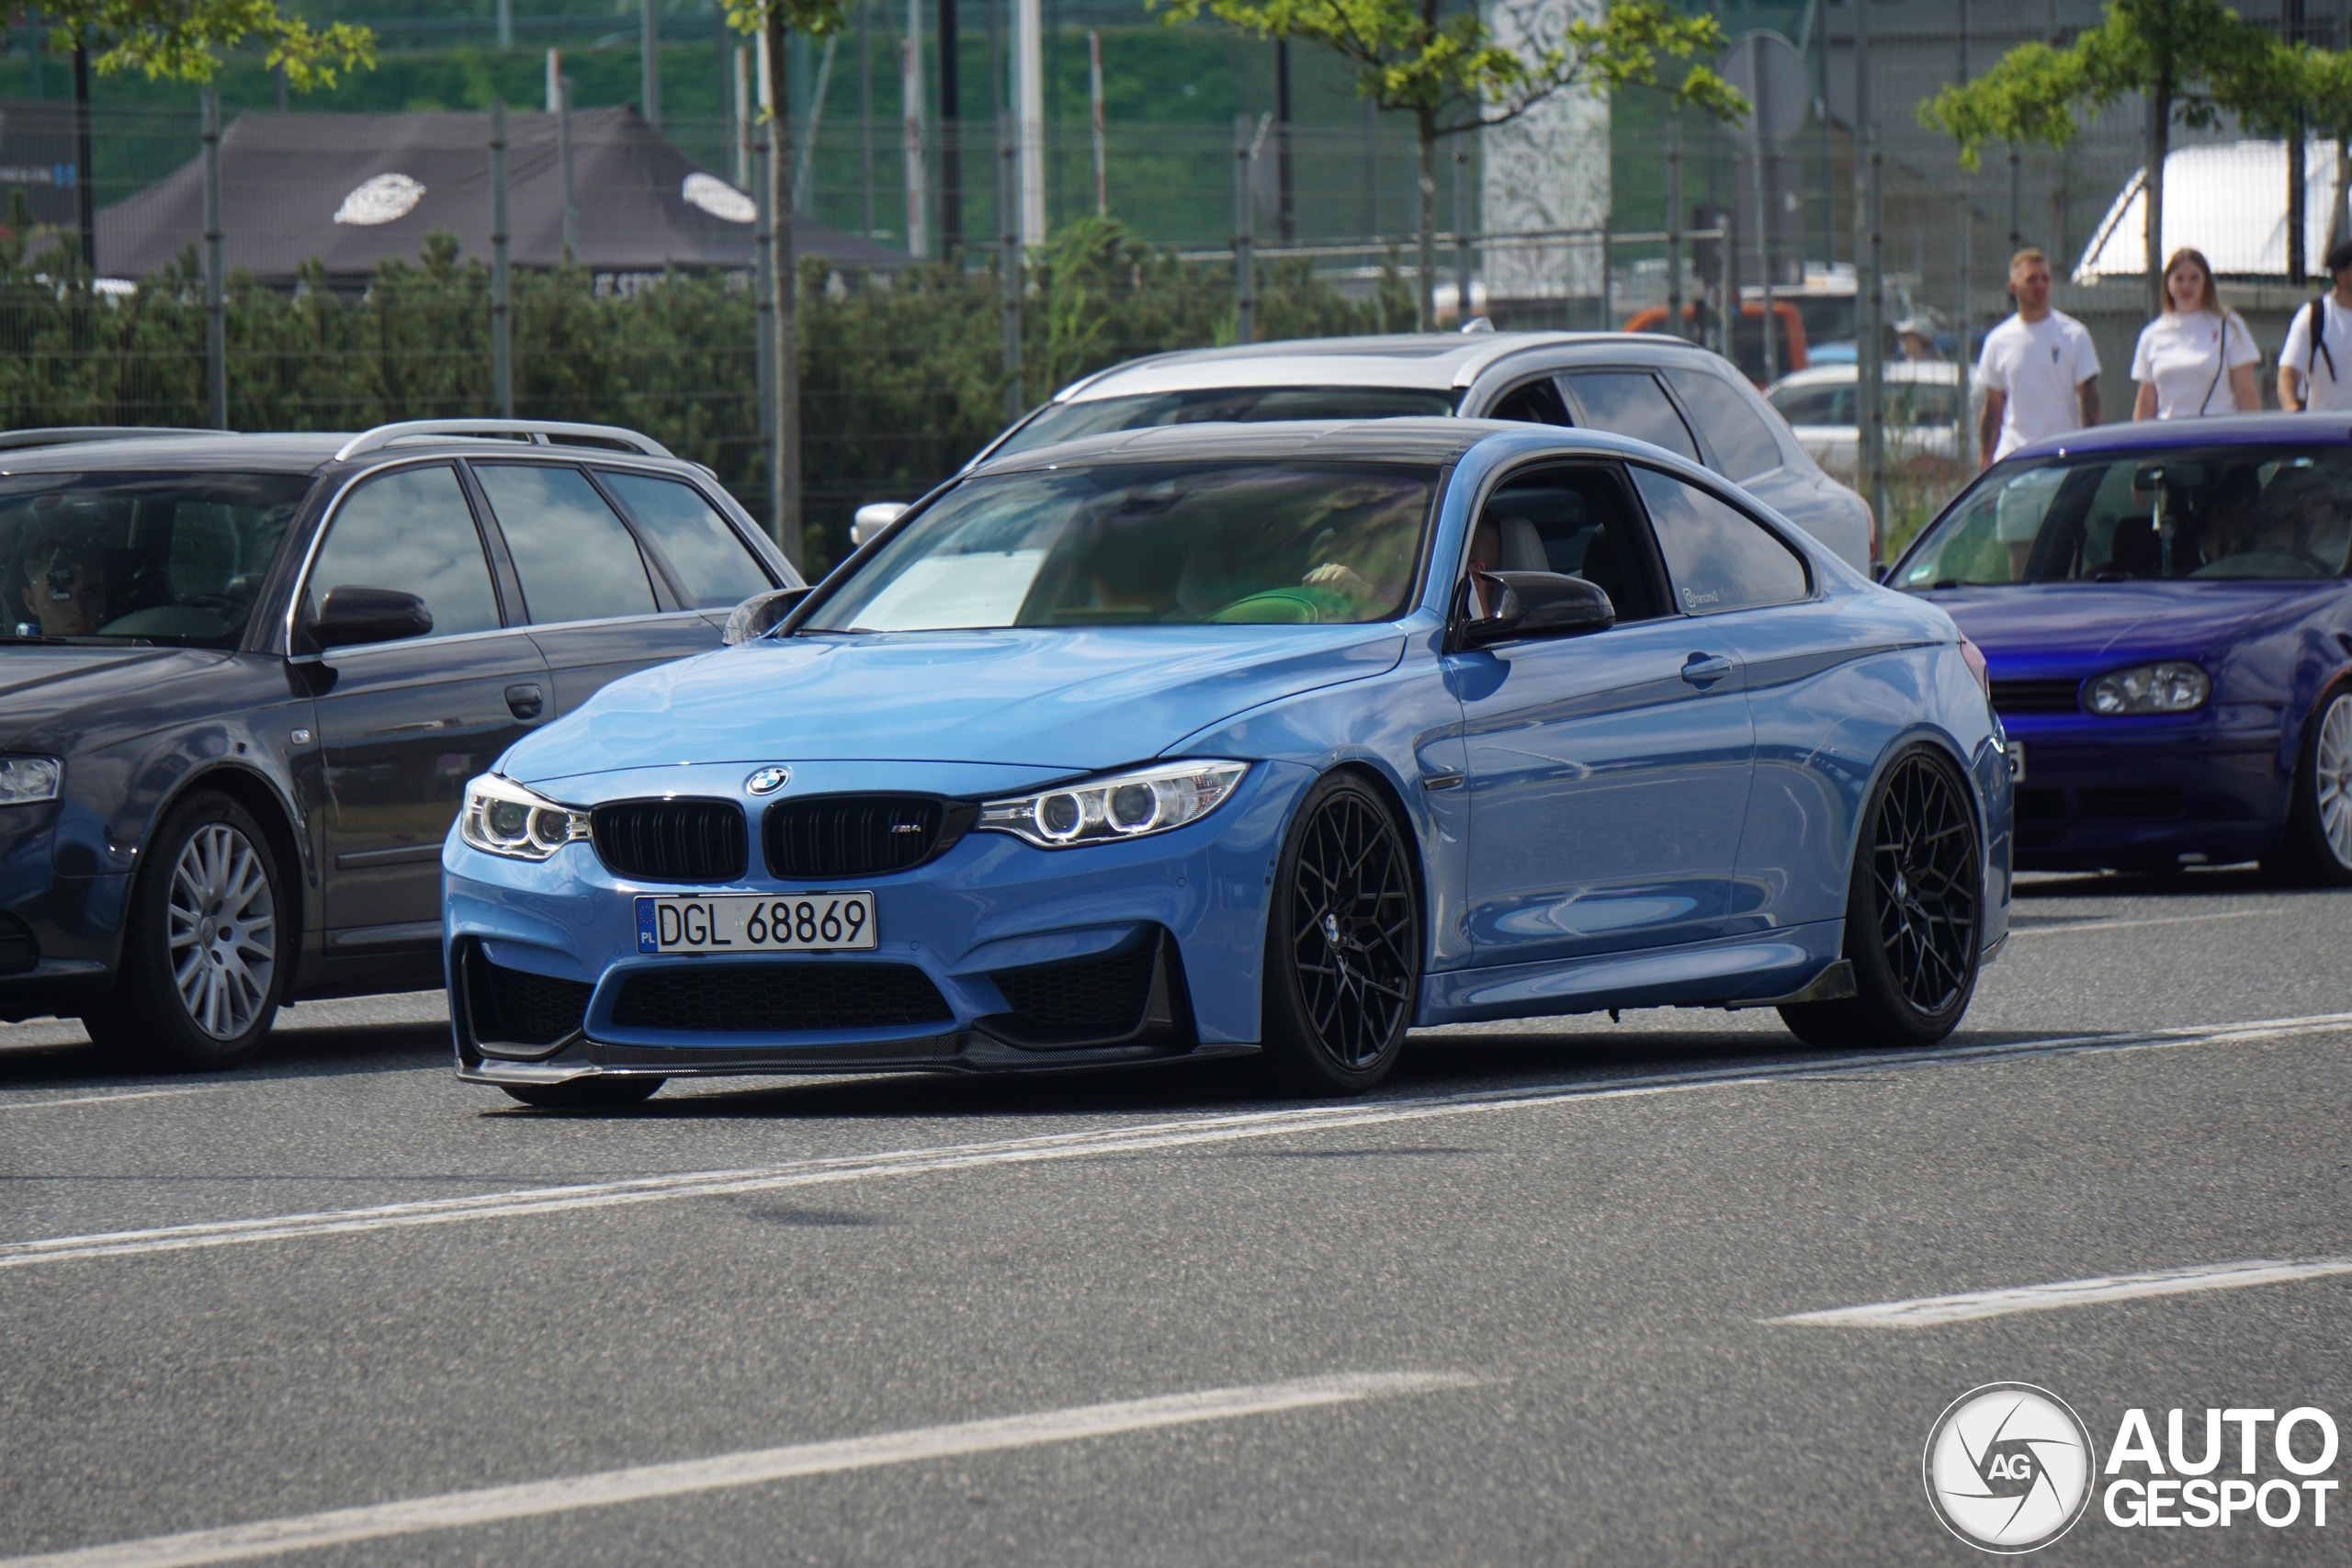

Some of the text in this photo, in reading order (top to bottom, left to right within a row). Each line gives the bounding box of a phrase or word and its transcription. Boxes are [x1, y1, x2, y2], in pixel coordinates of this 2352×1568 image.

[892, 824, 922, 833] M4
[657, 899, 866, 946] DGL 68869
[641, 931, 655, 944] PL
